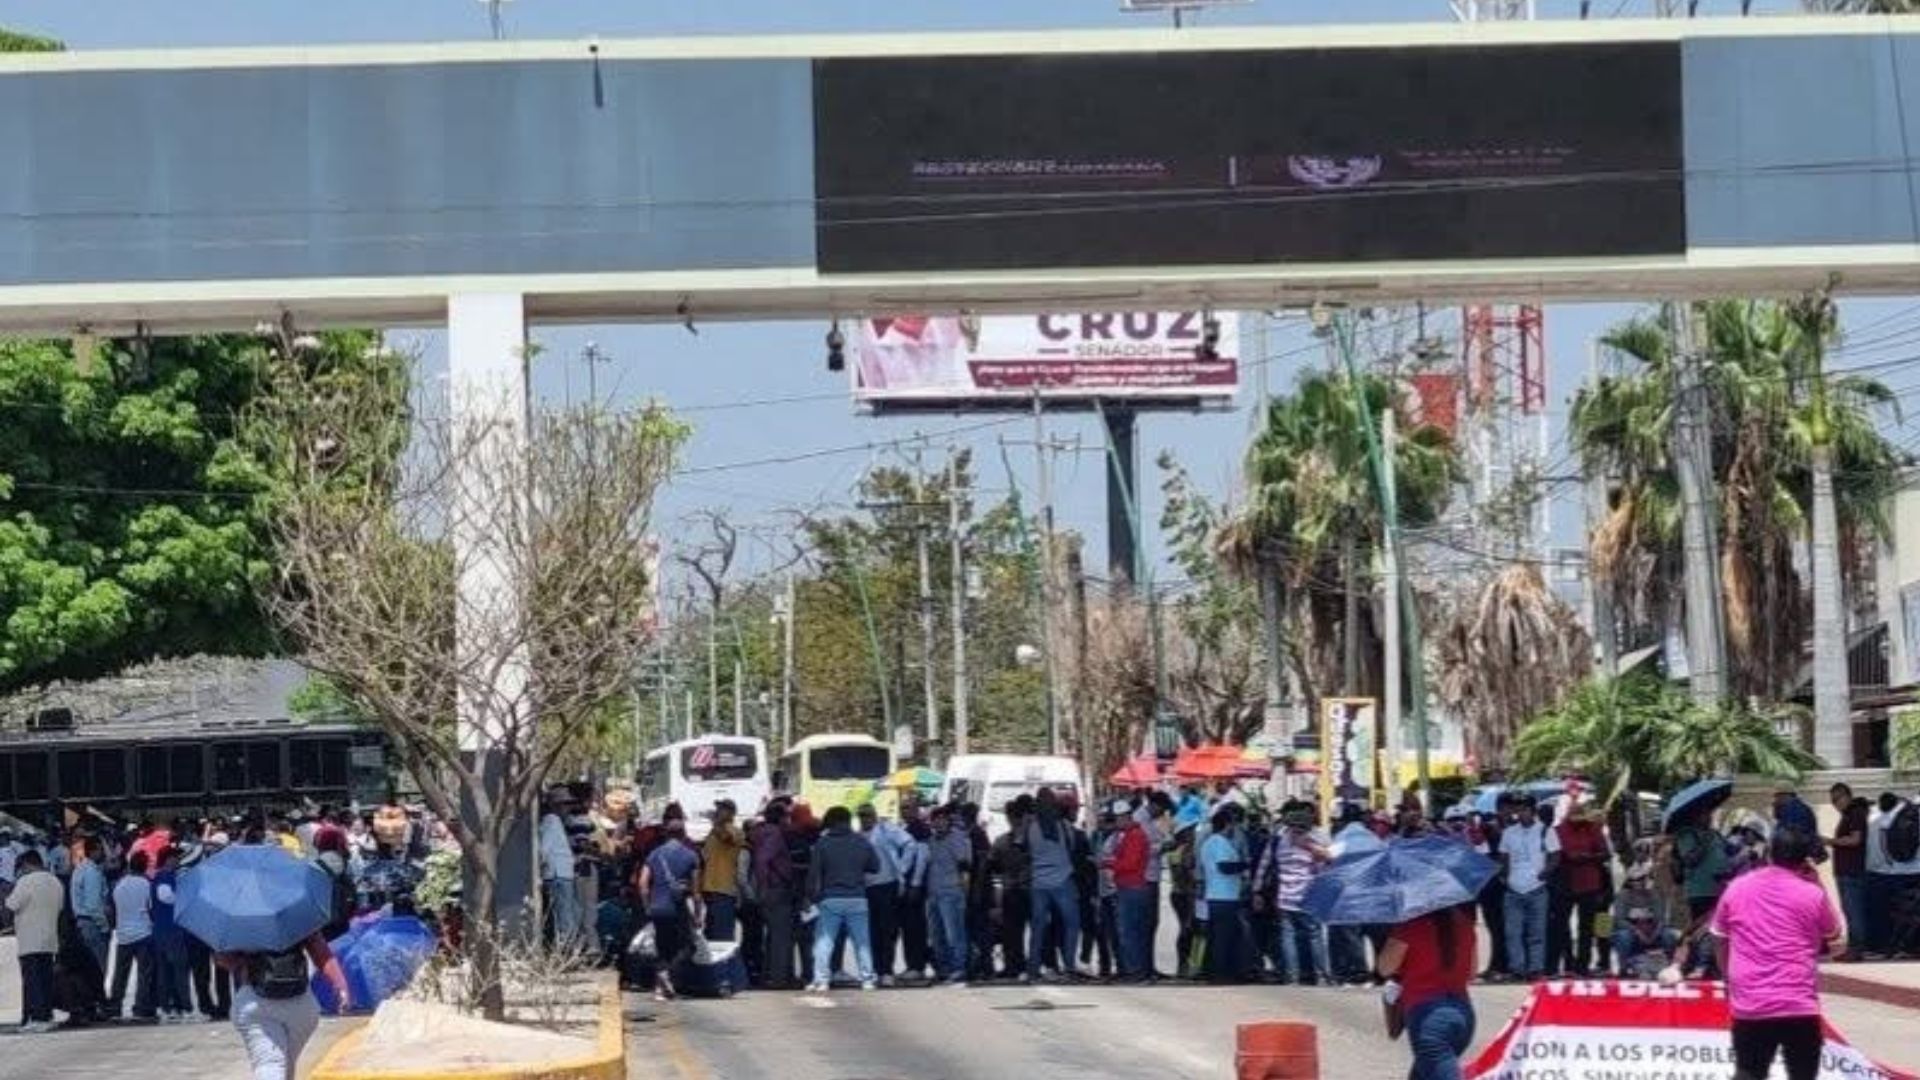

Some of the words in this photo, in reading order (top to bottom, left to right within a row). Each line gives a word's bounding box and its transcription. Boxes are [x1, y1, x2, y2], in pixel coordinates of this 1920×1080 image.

[1037, 311, 1199, 341] CRUZ
[1077, 344, 1163, 356] SENADOR
[1575, 1043, 1591, 1060] A
[1598, 1043, 1643, 1061] LOS
